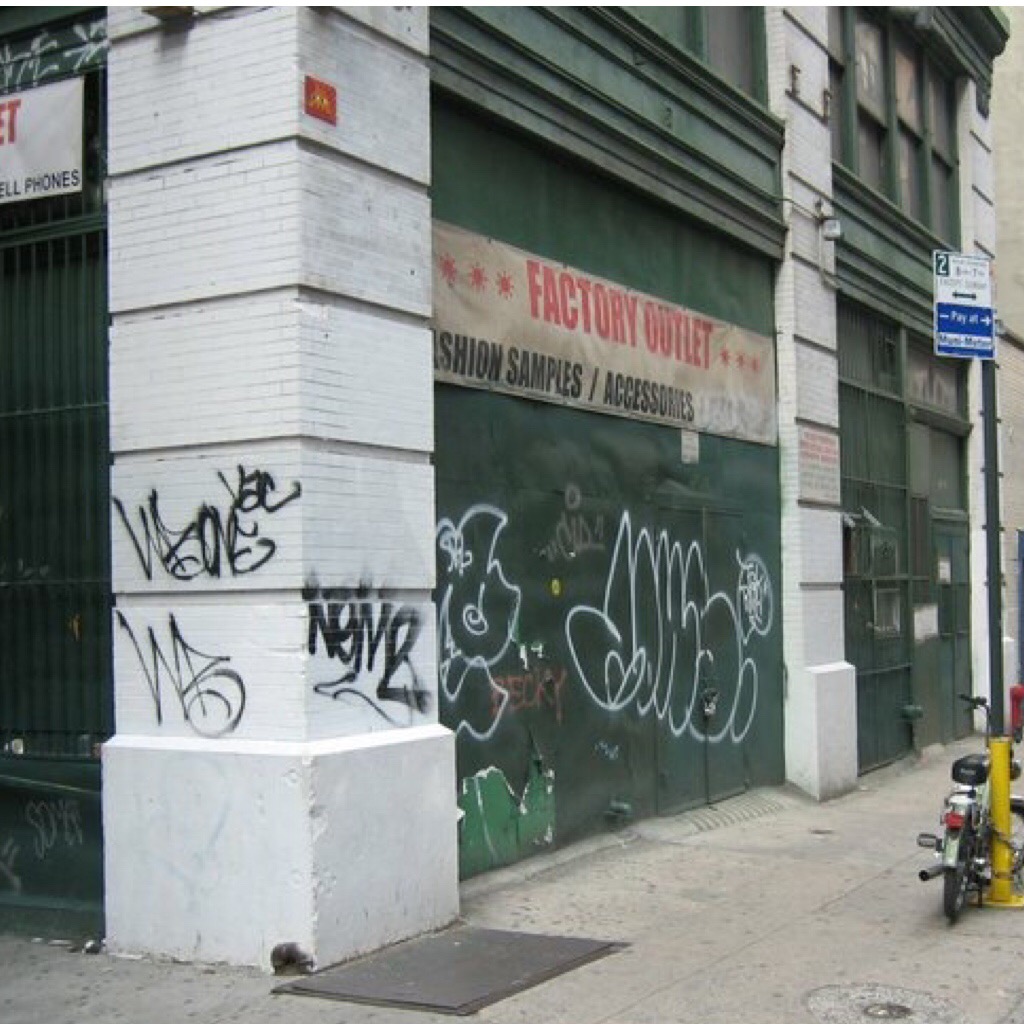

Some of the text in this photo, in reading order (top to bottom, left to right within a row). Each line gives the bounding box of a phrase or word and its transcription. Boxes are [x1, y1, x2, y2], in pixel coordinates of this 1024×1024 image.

[25, 169, 80, 192] PHONES
[937, 255, 947, 274] 2
[526, 259, 713, 370] FACTORY OUTLET
[506, 346, 583, 398] SAMPLES
[603, 371, 695, 422] ACCESSORIES
